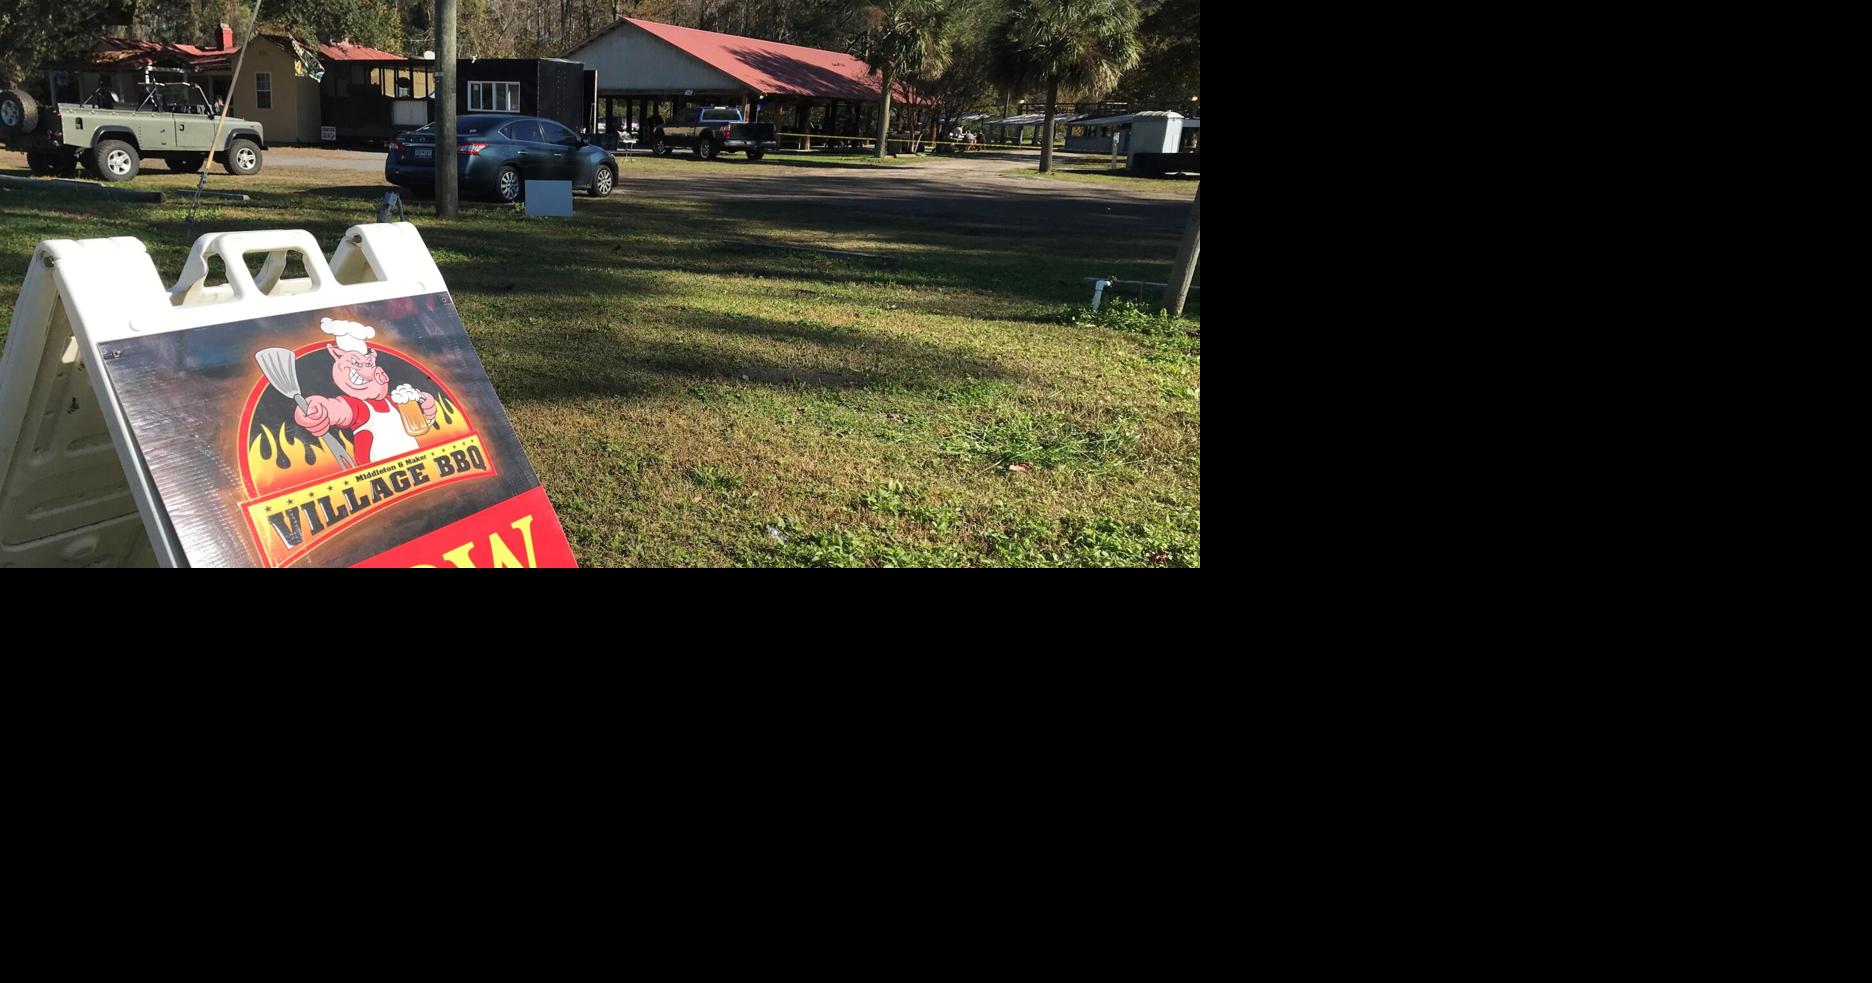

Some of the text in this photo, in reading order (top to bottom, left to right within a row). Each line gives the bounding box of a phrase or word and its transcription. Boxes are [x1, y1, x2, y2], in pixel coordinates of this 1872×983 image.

[267, 445, 487, 550] VILLAGE BBQ
[355, 465, 397, 482] Middleton
[405, 454, 427, 465] Maker
